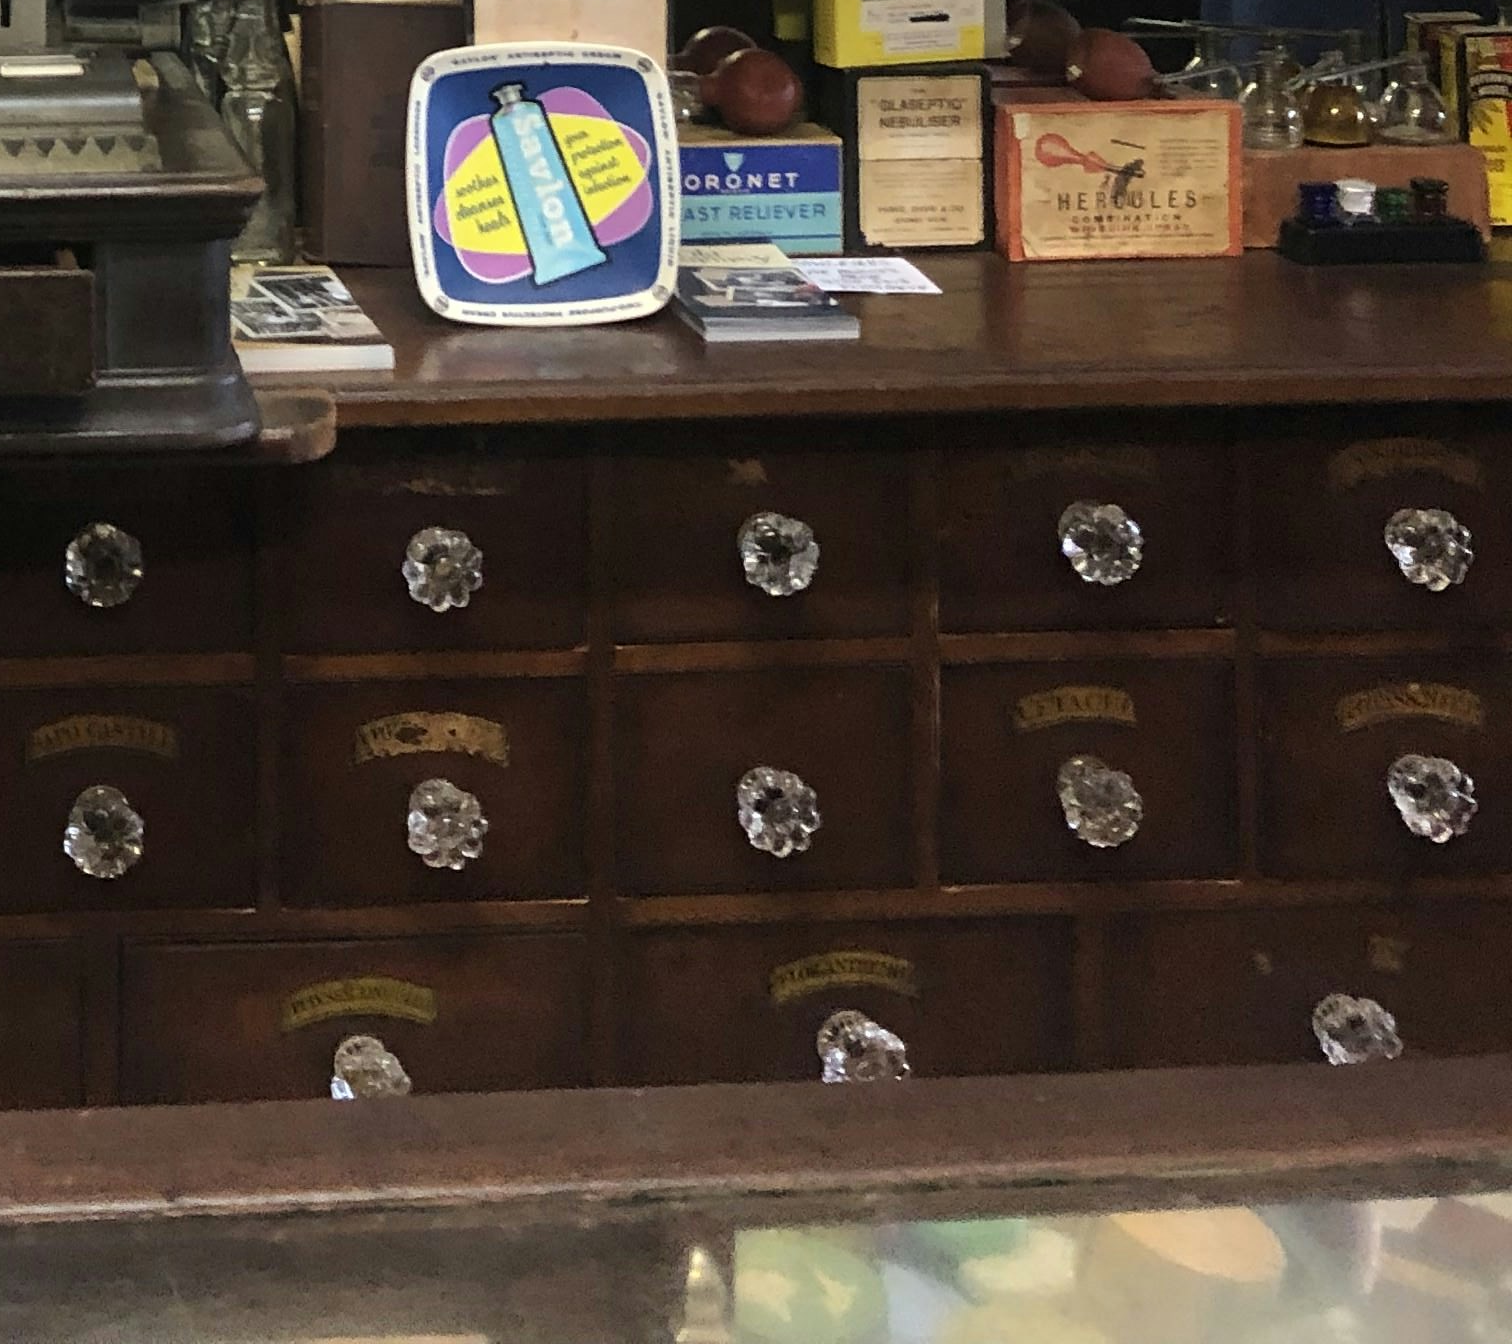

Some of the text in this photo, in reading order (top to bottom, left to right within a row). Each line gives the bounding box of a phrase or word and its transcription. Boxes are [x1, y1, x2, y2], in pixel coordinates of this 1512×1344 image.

[684, 172, 800, 190] ORONET
[1057, 190, 1198, 211] HERCULES
[684, 203, 826, 222] AST RELIEVER
